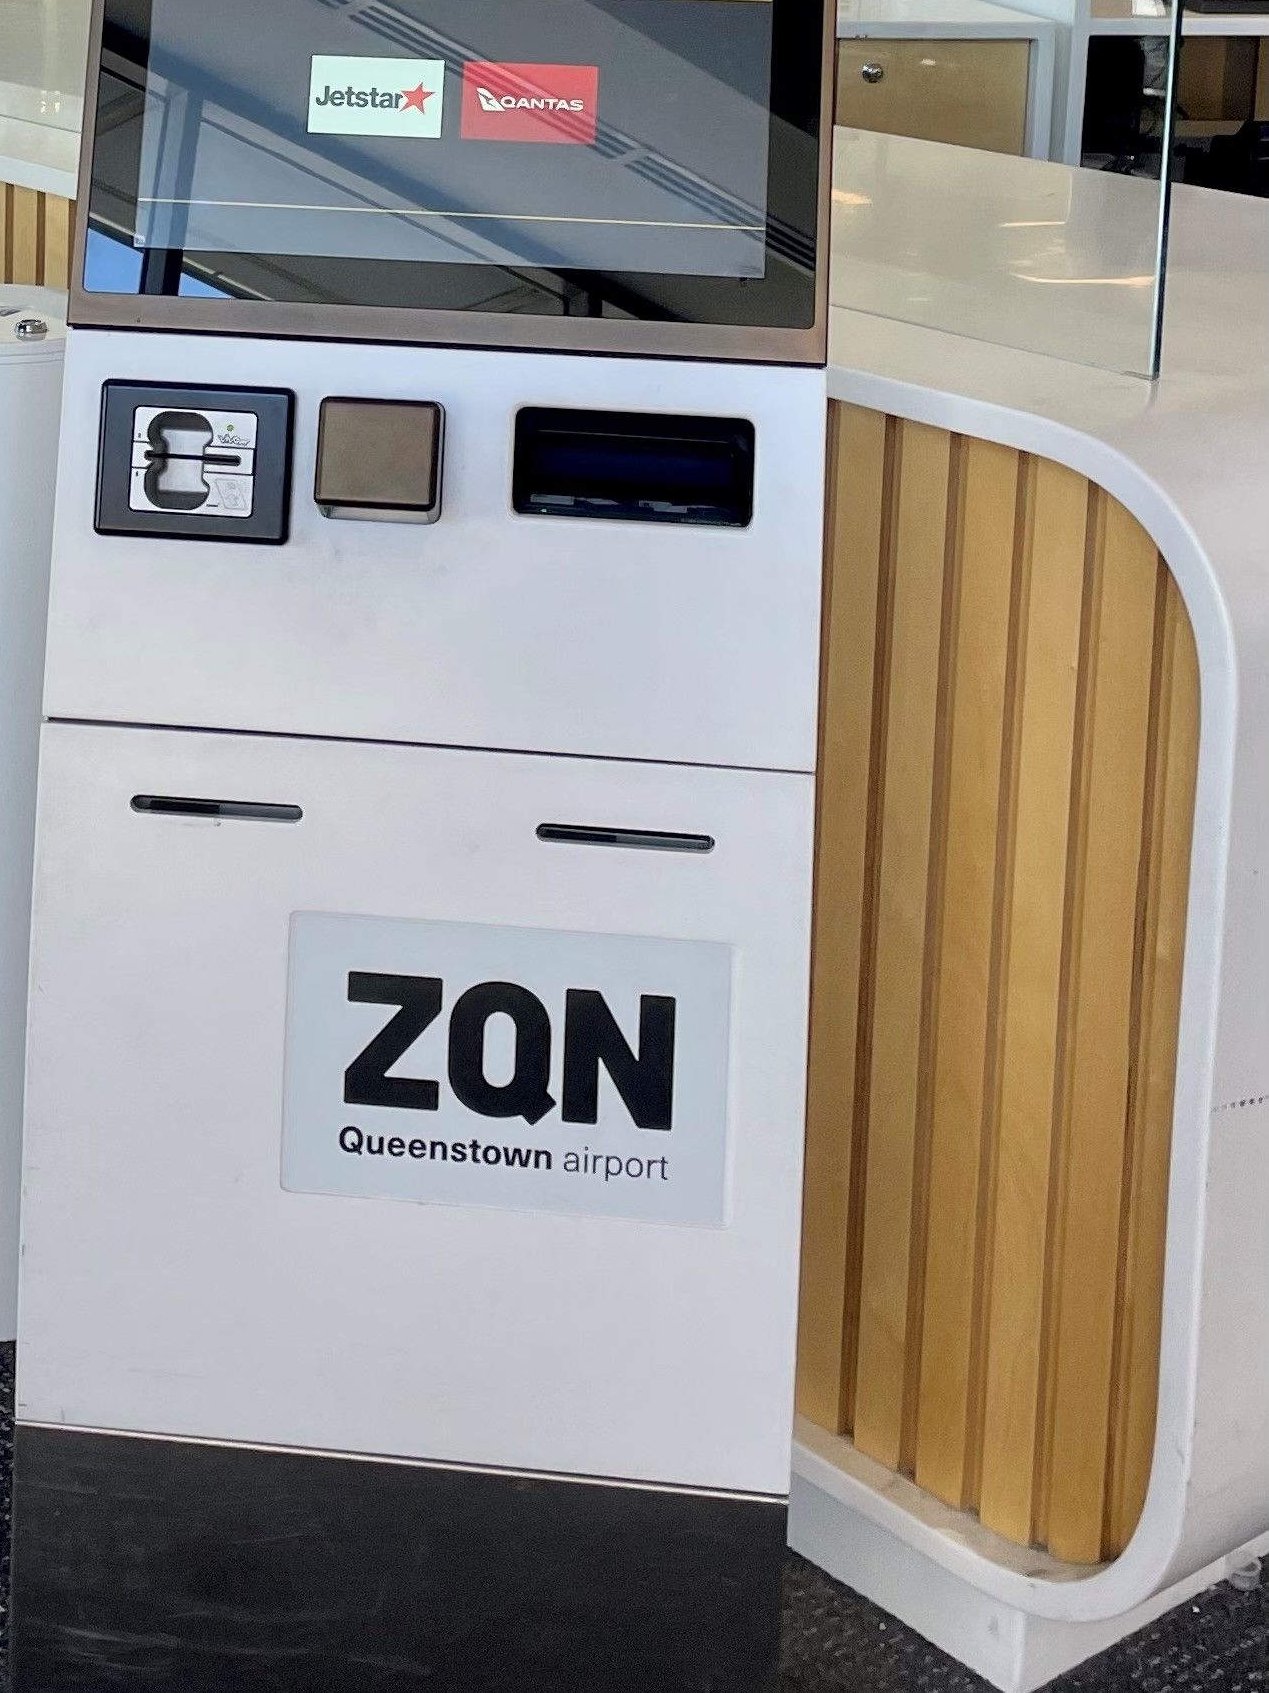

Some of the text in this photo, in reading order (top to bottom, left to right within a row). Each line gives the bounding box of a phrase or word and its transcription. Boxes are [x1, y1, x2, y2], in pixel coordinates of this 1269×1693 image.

[315, 85, 584, 111] Jetstar QANTAS
[343, 971, 676, 1131] ZQN
[339, 1125, 669, 1182] Queenstown airport
